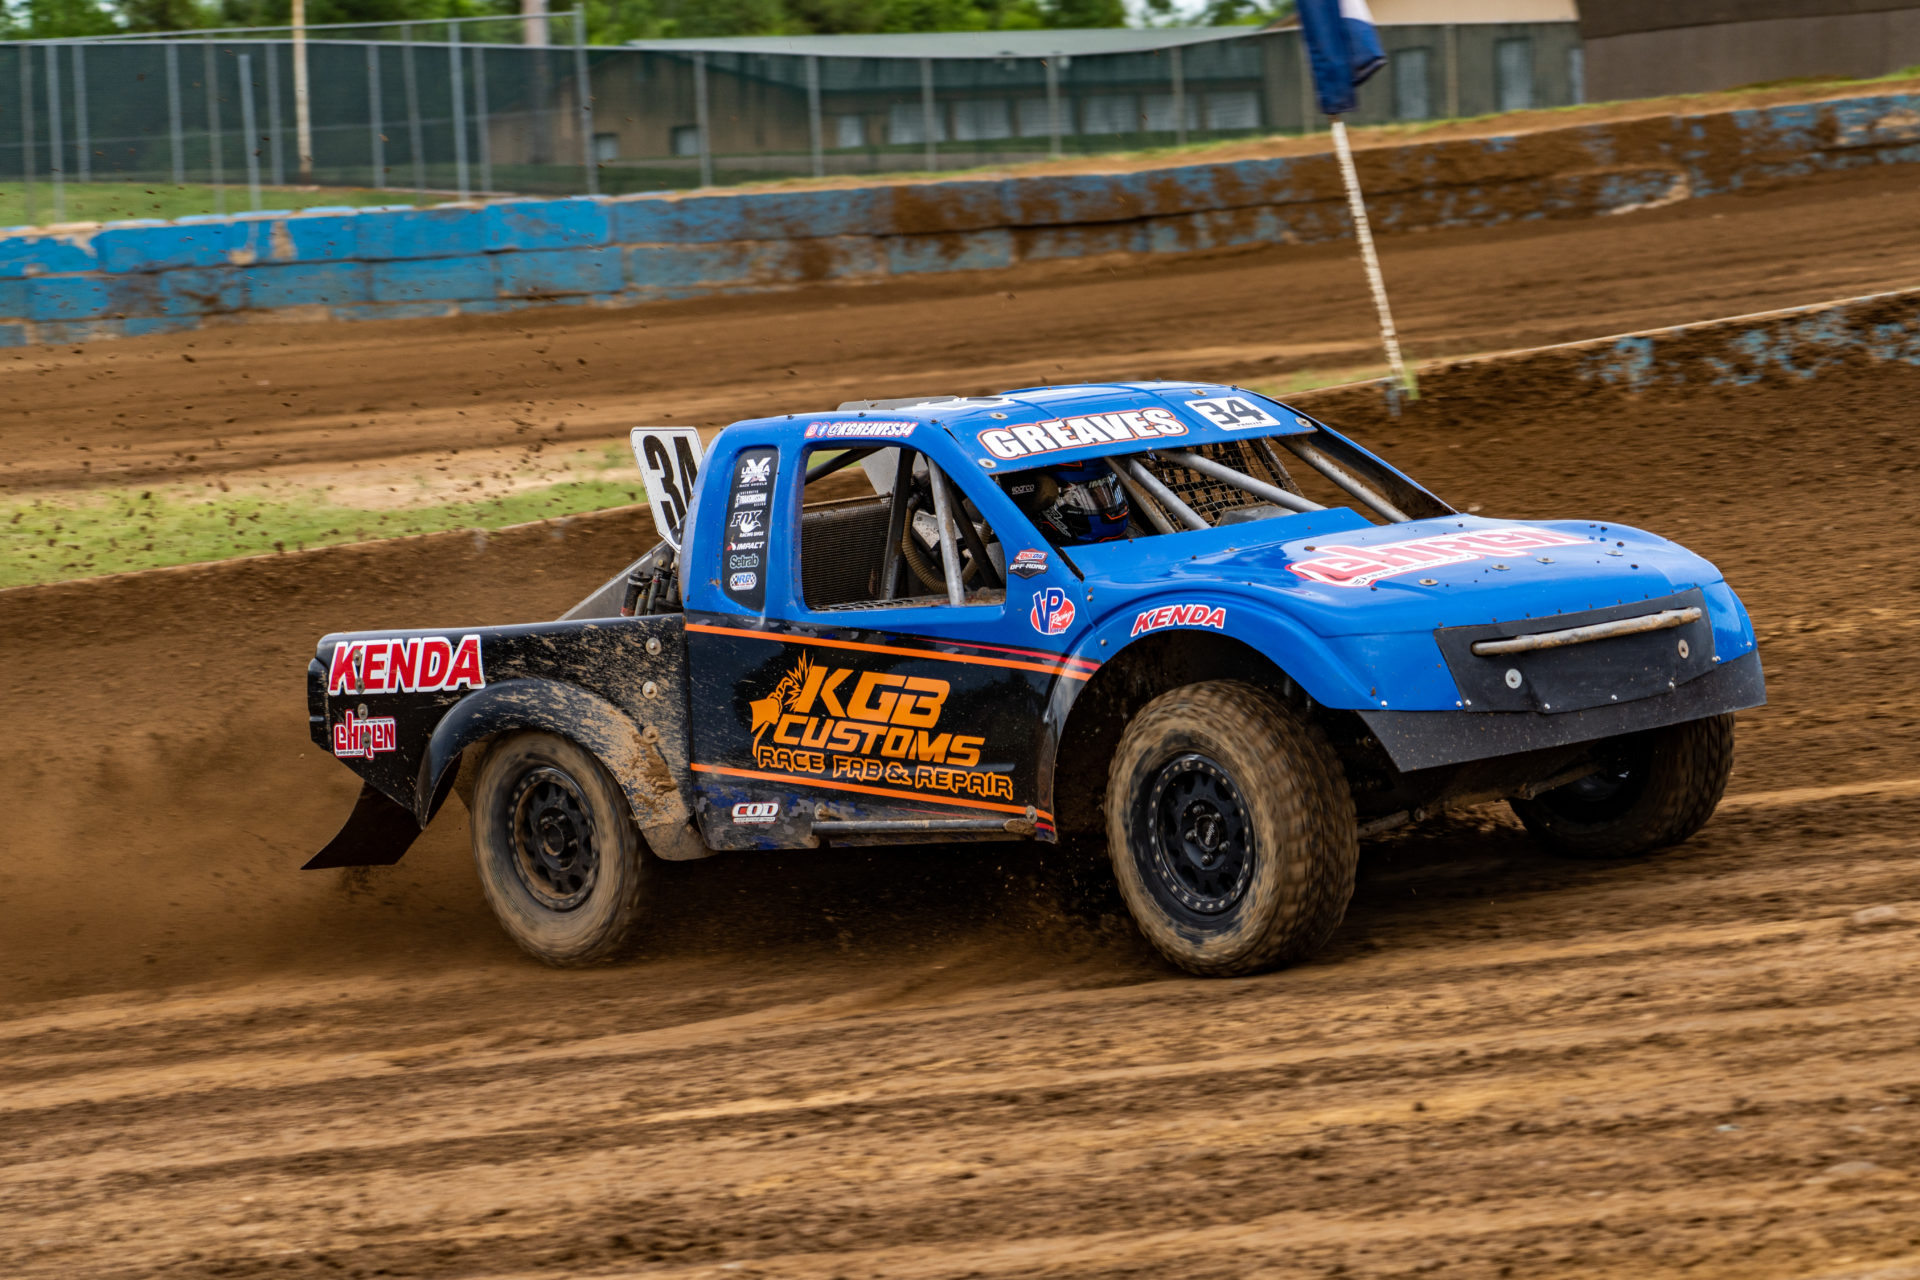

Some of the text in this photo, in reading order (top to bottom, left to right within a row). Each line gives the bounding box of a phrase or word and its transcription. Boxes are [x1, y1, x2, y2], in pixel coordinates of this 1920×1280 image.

[1192, 400, 1267, 425] 34
[827, 422, 917, 437] @KGREAVES34
[979, 407, 1188, 459] GREAVES
[730, 510, 763, 528] FOX
[736, 541, 765, 551] IMPACT
[730, 553, 759, 569] Setrab
[1009, 563, 1047, 571] OFF-ROAD
[1033, 588, 1065, 635] VP
[1130, 604, 1226, 637] KENDA
[328, 634, 486, 696] KENDA
[795, 665, 950, 729] KGB
[773, 713, 985, 767] CUSTOMS
[758, 745, 1013, 800] RACE FAB & REPAIR
[732, 803, 779, 817] COD
